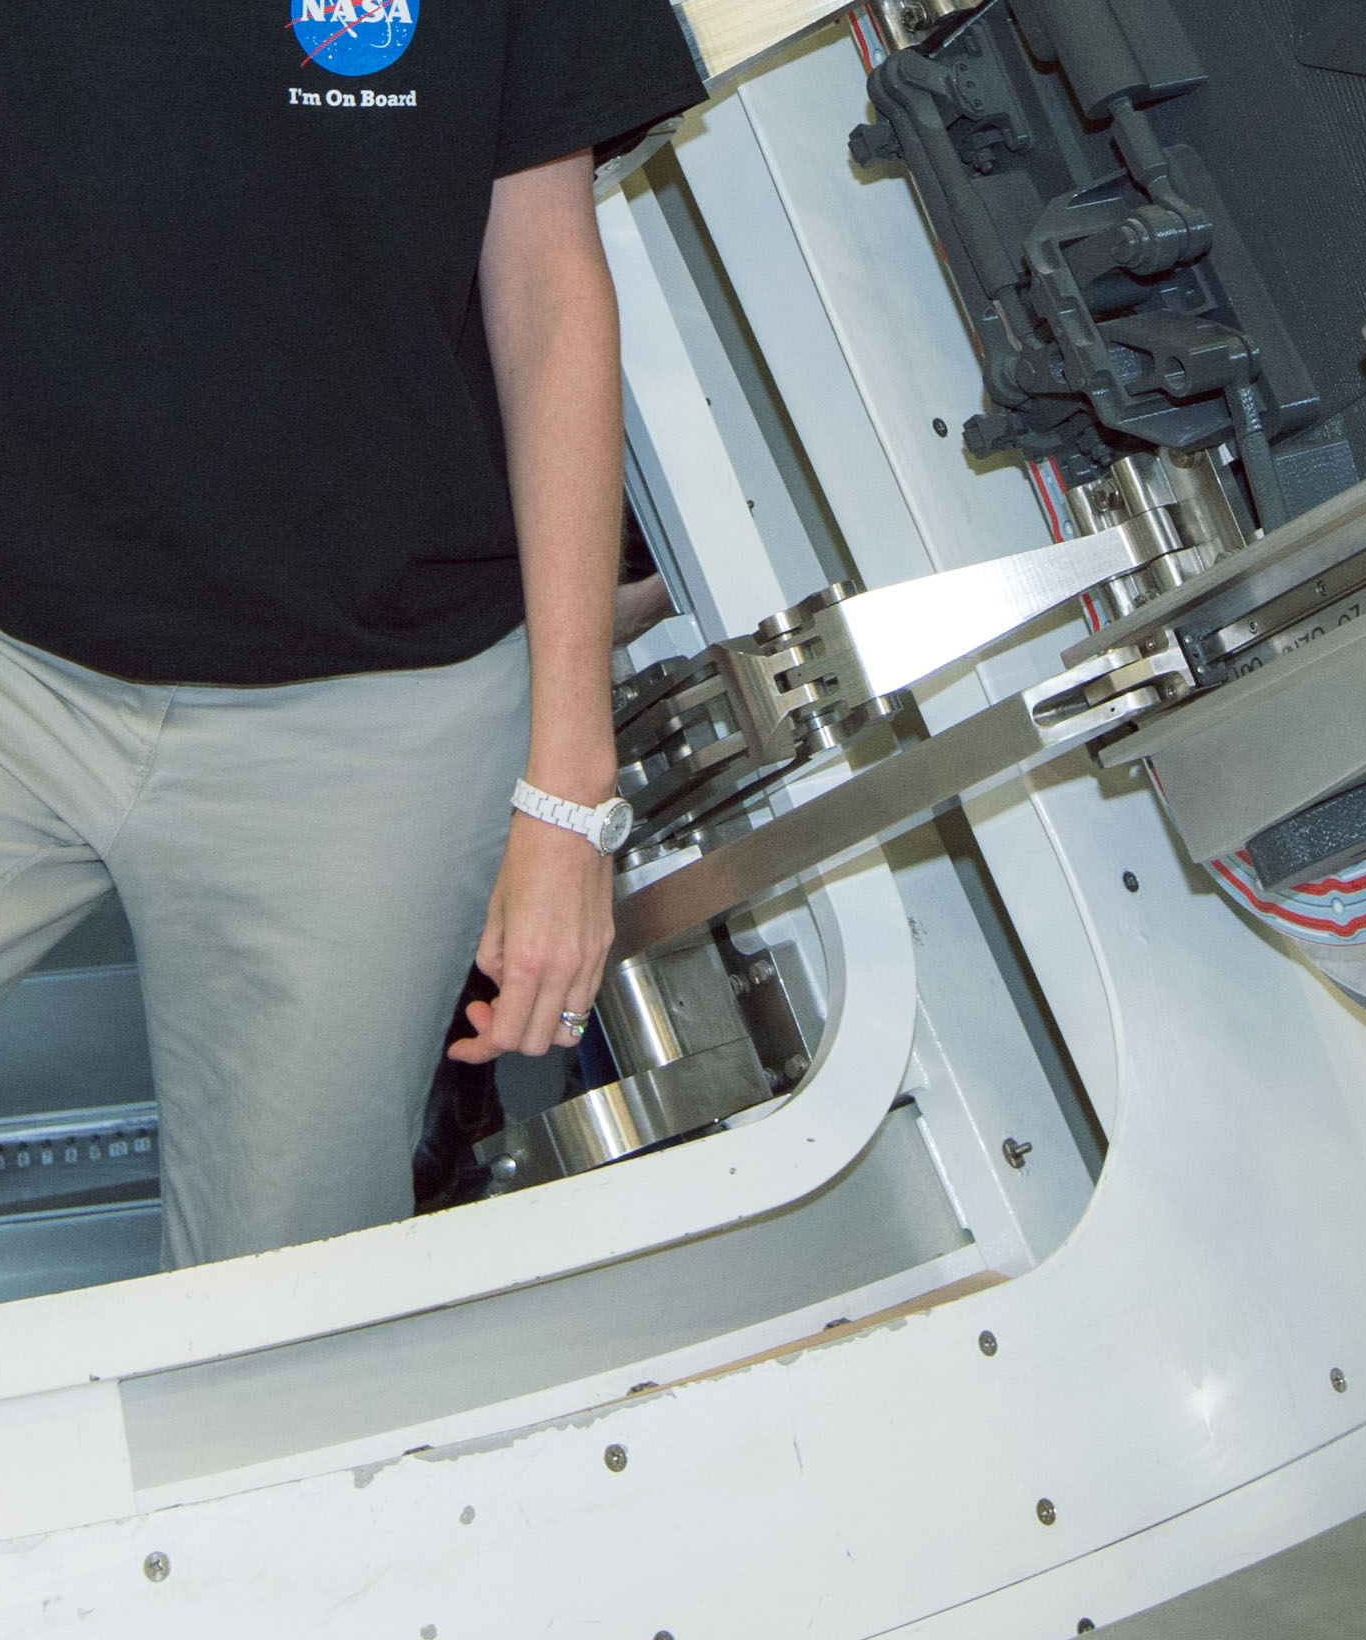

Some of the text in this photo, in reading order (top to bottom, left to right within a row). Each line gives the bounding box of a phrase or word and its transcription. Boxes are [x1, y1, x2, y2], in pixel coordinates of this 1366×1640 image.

[289, 88, 417, 107] I'm On Board
